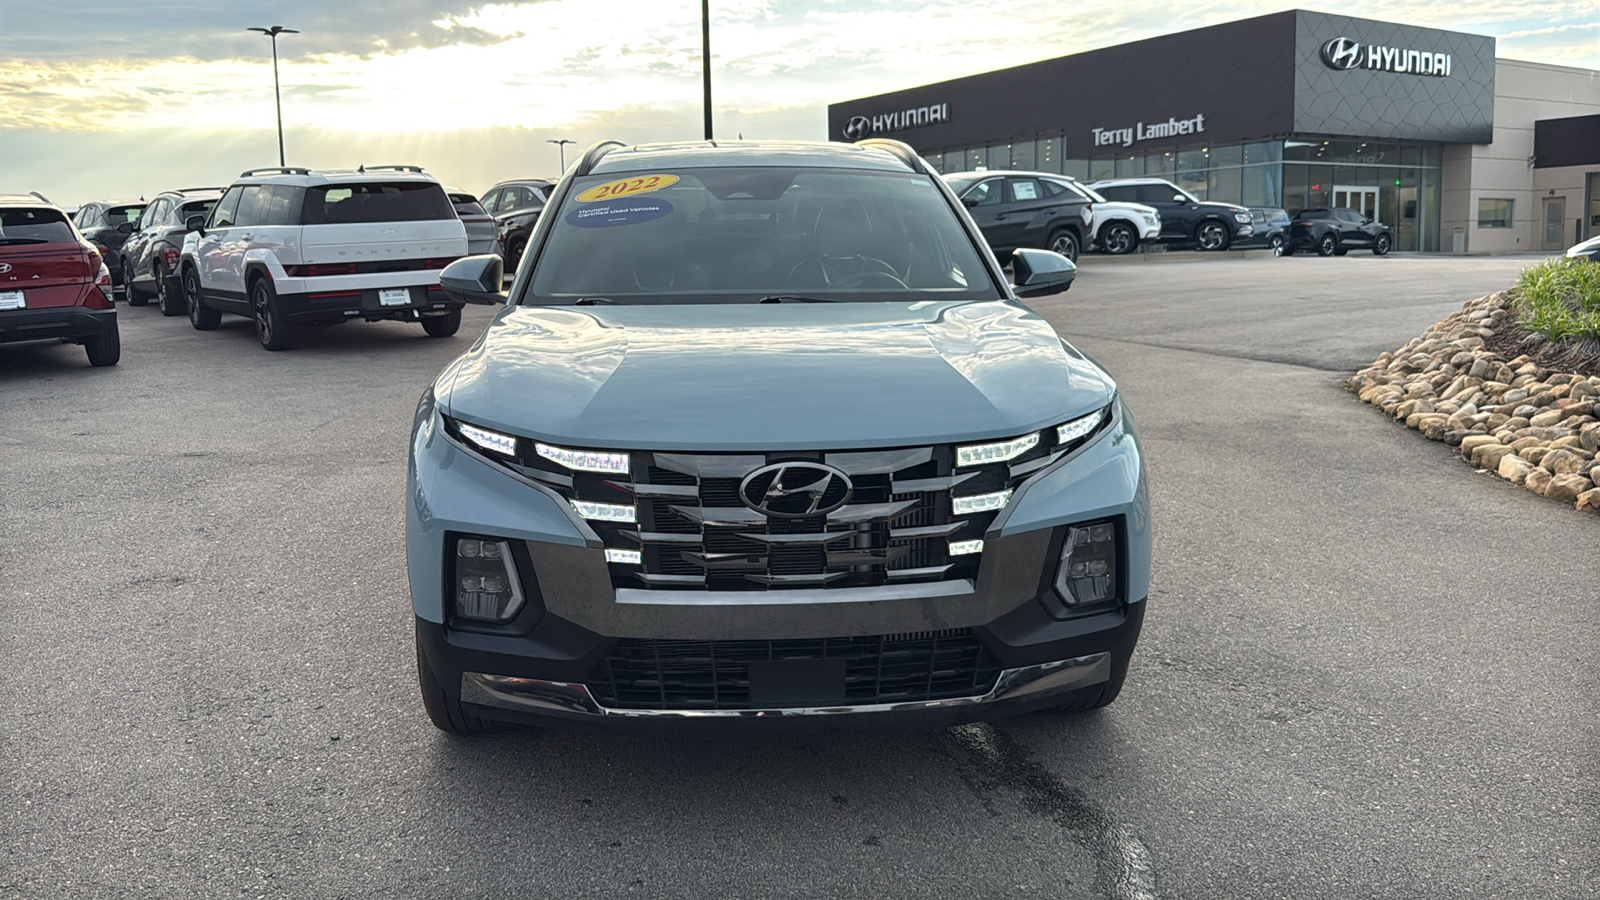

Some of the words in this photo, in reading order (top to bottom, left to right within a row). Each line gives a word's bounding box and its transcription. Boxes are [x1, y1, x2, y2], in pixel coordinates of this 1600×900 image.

[1367, 44, 1451, 77] HYUNDAI
[872, 103, 947, 132] HYUNDAI
[1091, 127, 1133, 147] Terry
[1136, 113, 1205, 141] Lambert
[593, 176, 660, 199] 2022
[577, 210, 609, 218] Certified
[578, 206, 610, 214] Hyundai
[338, 248, 408, 256] SANTA
